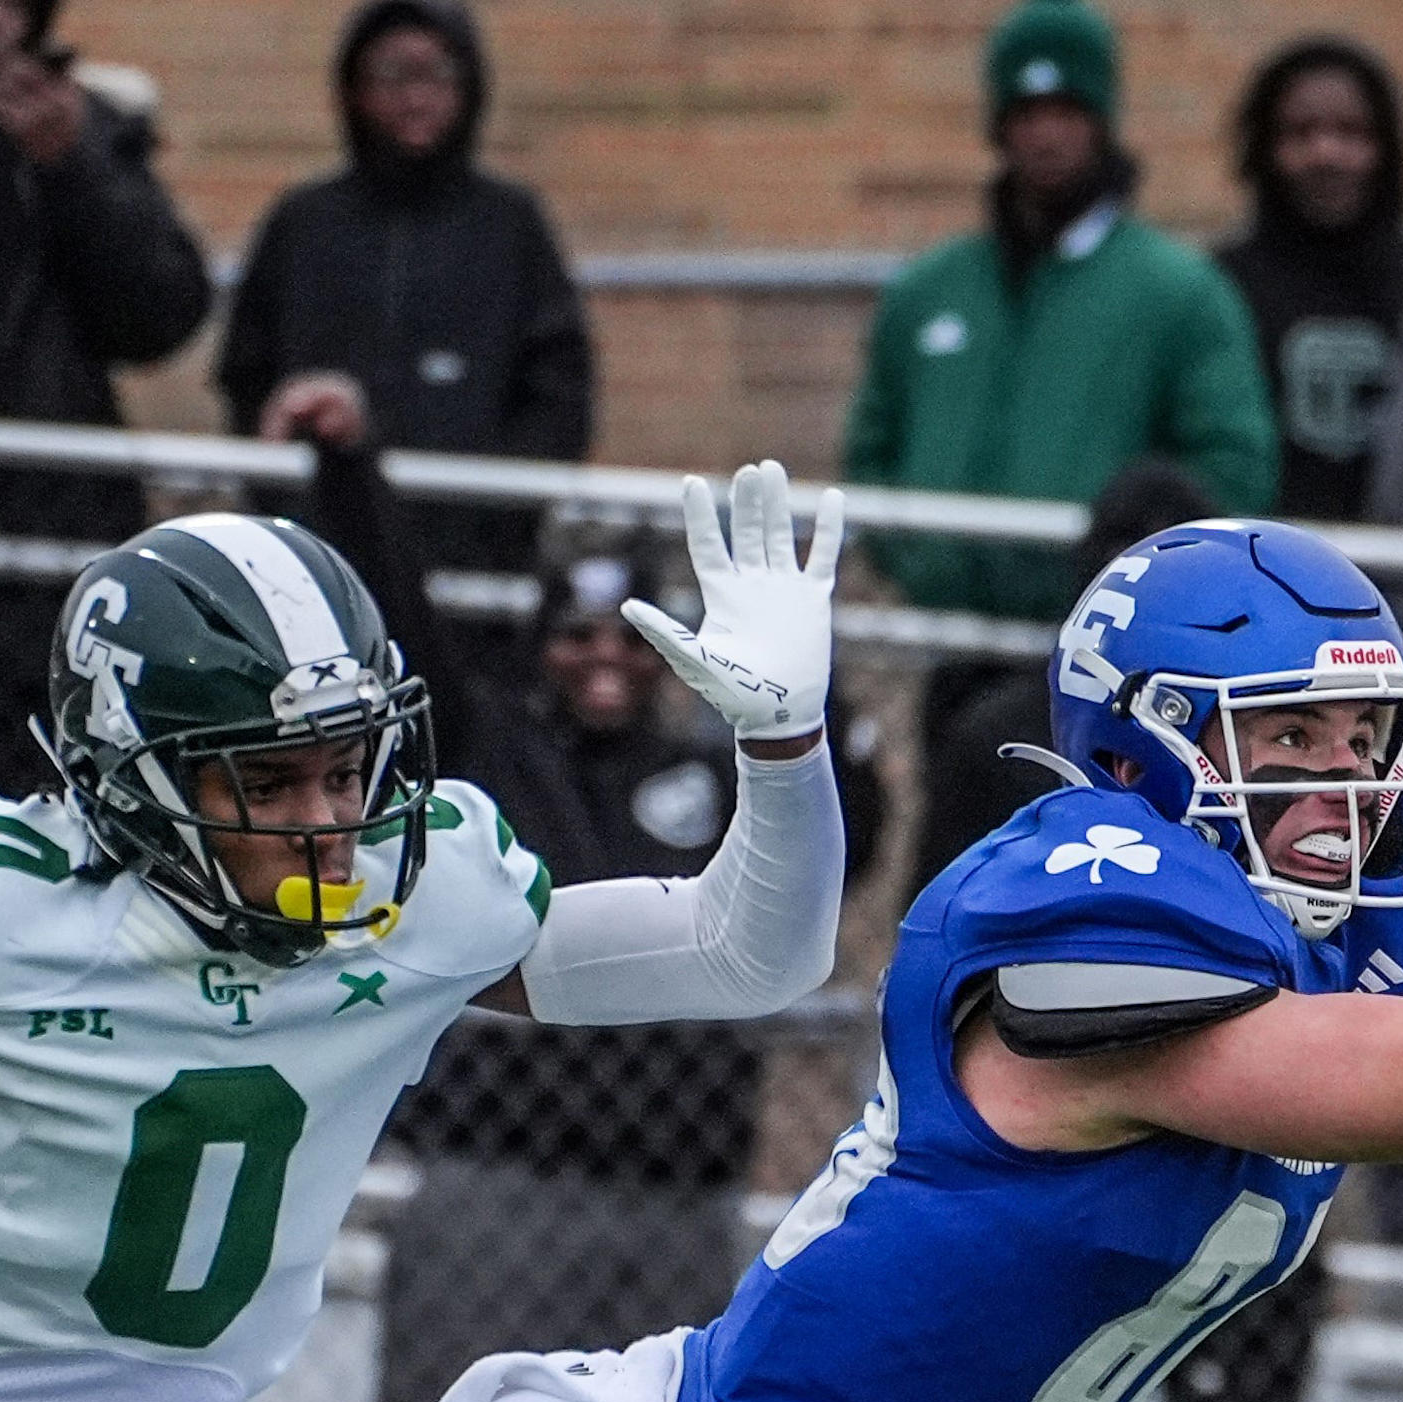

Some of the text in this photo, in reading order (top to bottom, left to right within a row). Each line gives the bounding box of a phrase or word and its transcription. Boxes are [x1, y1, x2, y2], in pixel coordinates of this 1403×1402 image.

[1329, 648, 1397, 665] Riddell
[1196, 755, 1238, 808] Ride
[28, 1008, 113, 1040] PSL
[83, 1064, 308, 1349] 0
